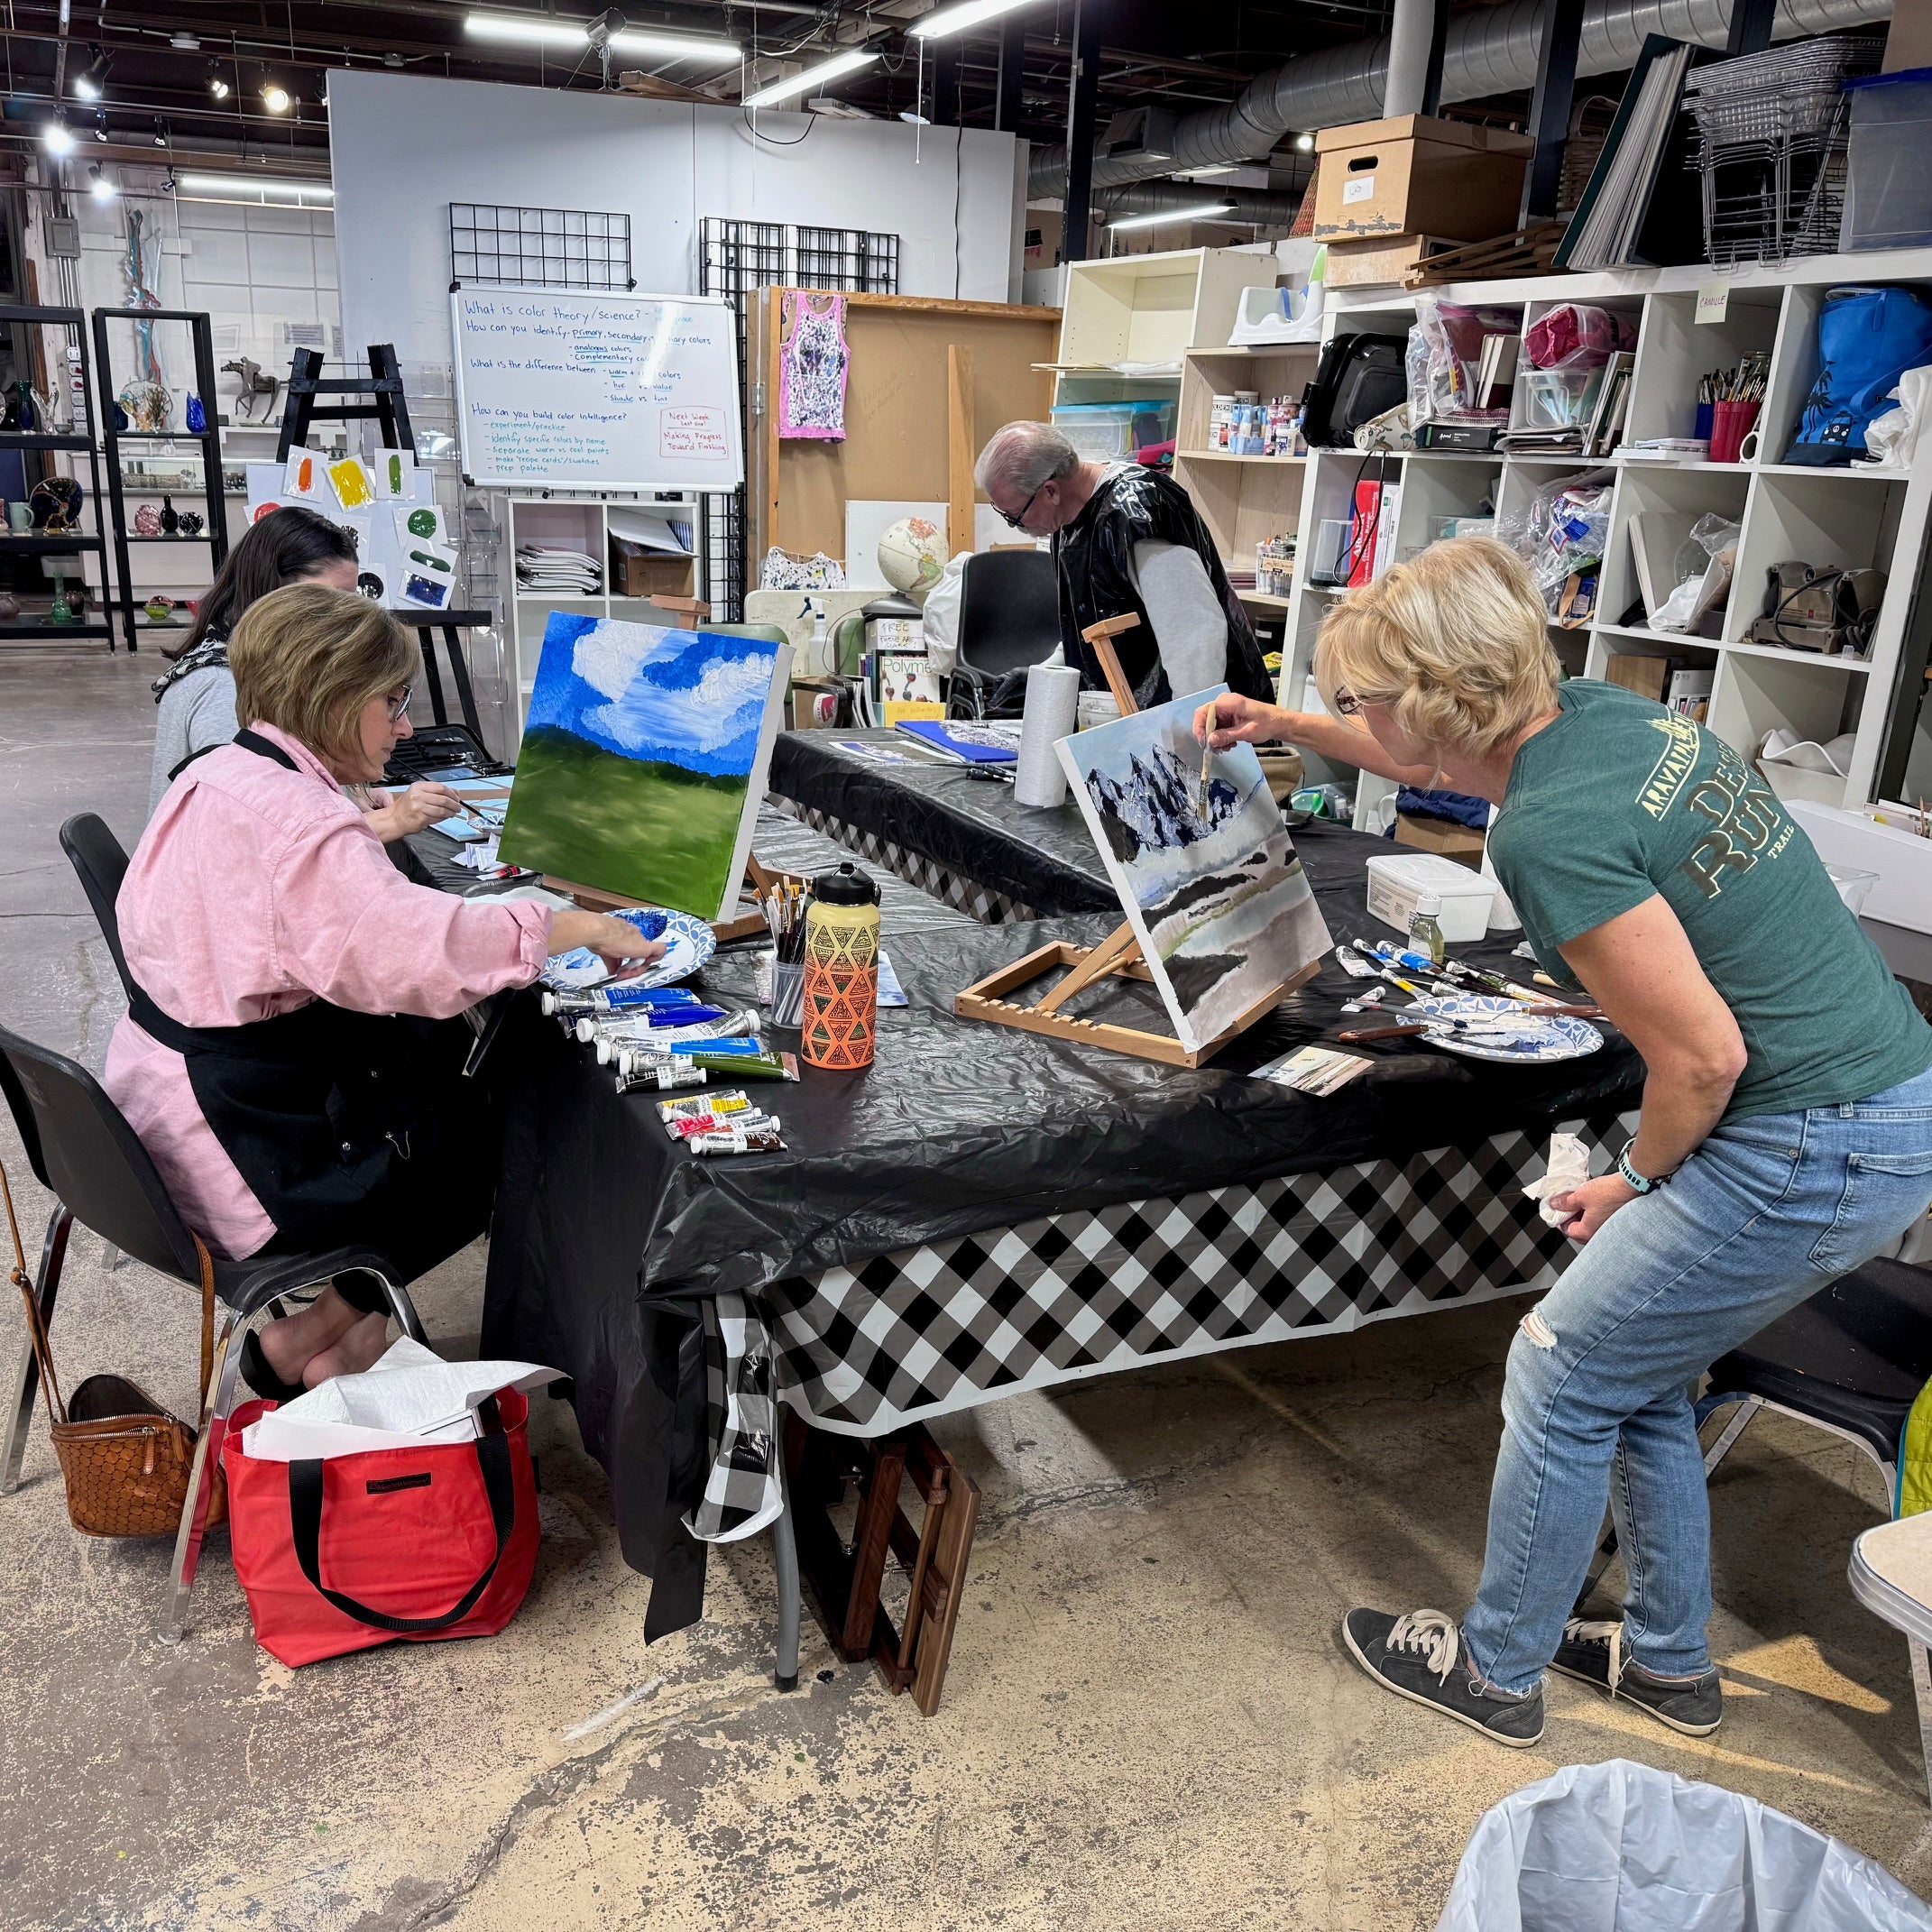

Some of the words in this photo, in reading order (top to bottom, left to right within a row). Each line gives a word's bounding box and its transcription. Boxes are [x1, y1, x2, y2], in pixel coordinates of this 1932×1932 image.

[465, 300, 494, 314] What
[502, 303, 512, 315] is
[519, 305, 546, 317] color
[466, 320, 487, 332] How
[511, 327, 527, 336] you
[689, 336, 711, 345] colors
[575, 353, 632, 363] complementary
[471, 359, 493, 368] What
[498, 361, 506, 369] is
[509, 360, 521, 369] the
[525, 359, 563, 372] difference
[566, 363, 596, 373] between
[658, 371, 681, 380] colors
[613, 381, 625, 389] hue
[471, 402, 491, 416] How
[512, 411, 529, 421] you
[532, 410, 553, 419] build
[580, 412, 627, 423] intelligence?
[669, 411, 687, 419] Next
[692, 412, 710, 420] Week
[492, 432, 520, 445] identify
[524, 434, 550, 446] specific
[575, 436, 584, 445] by
[664, 431, 691, 444] Making
[695, 433, 722, 442] Progress
[520, 465, 549, 473] palette
[884, 657, 933, 675] Polyme
[1642, 741, 1697, 817] ARAVAIPA
[1767, 823, 1795, 860] TRAIL
